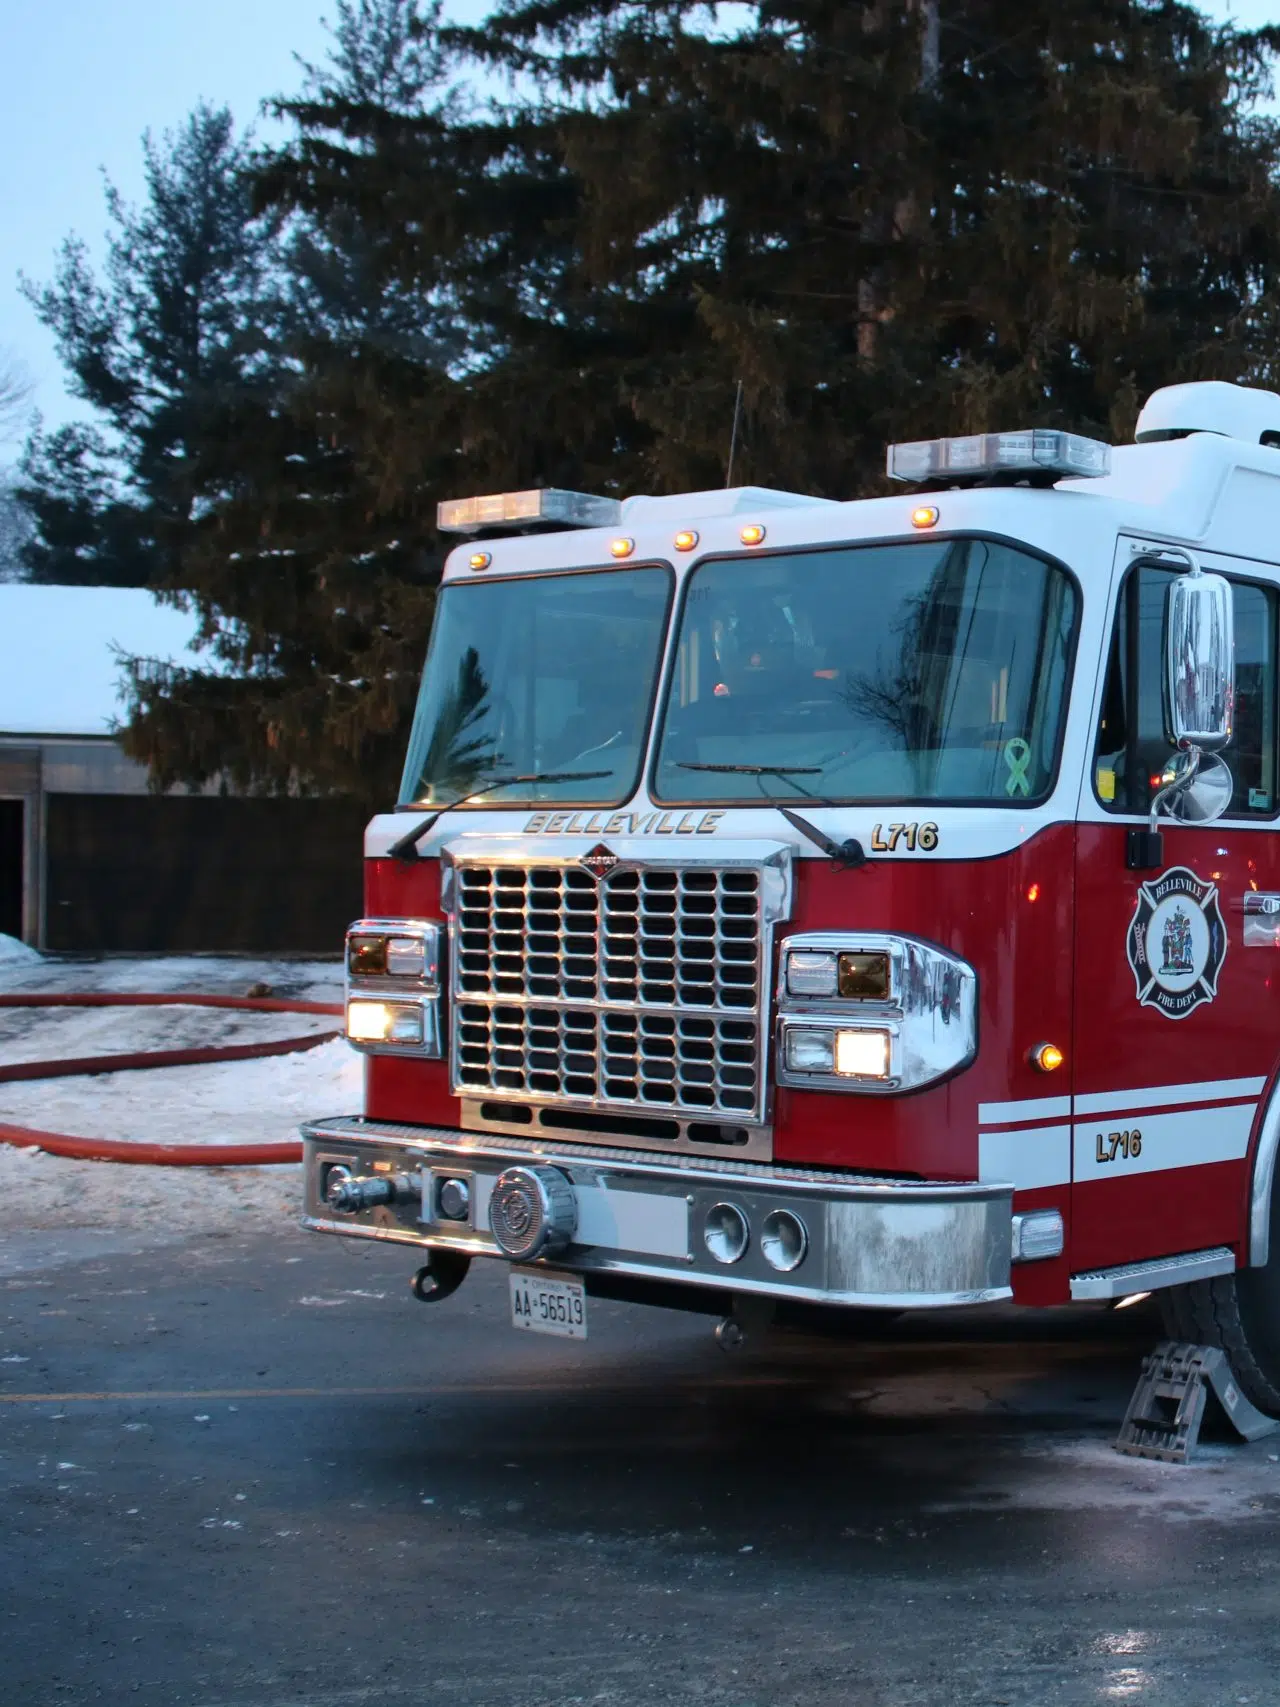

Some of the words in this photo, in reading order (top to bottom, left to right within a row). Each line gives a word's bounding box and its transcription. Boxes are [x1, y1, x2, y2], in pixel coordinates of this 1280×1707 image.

[522, 811, 725, 835] BELLEVILLE
[871, 822, 939, 852] L716
[1155, 877, 1203, 900] BELLEVILLE
[1157, 991, 1176, 1009] FIRE
[1176, 990, 1197, 1009] DEPT
[1096, 1129, 1142, 1163] L716
